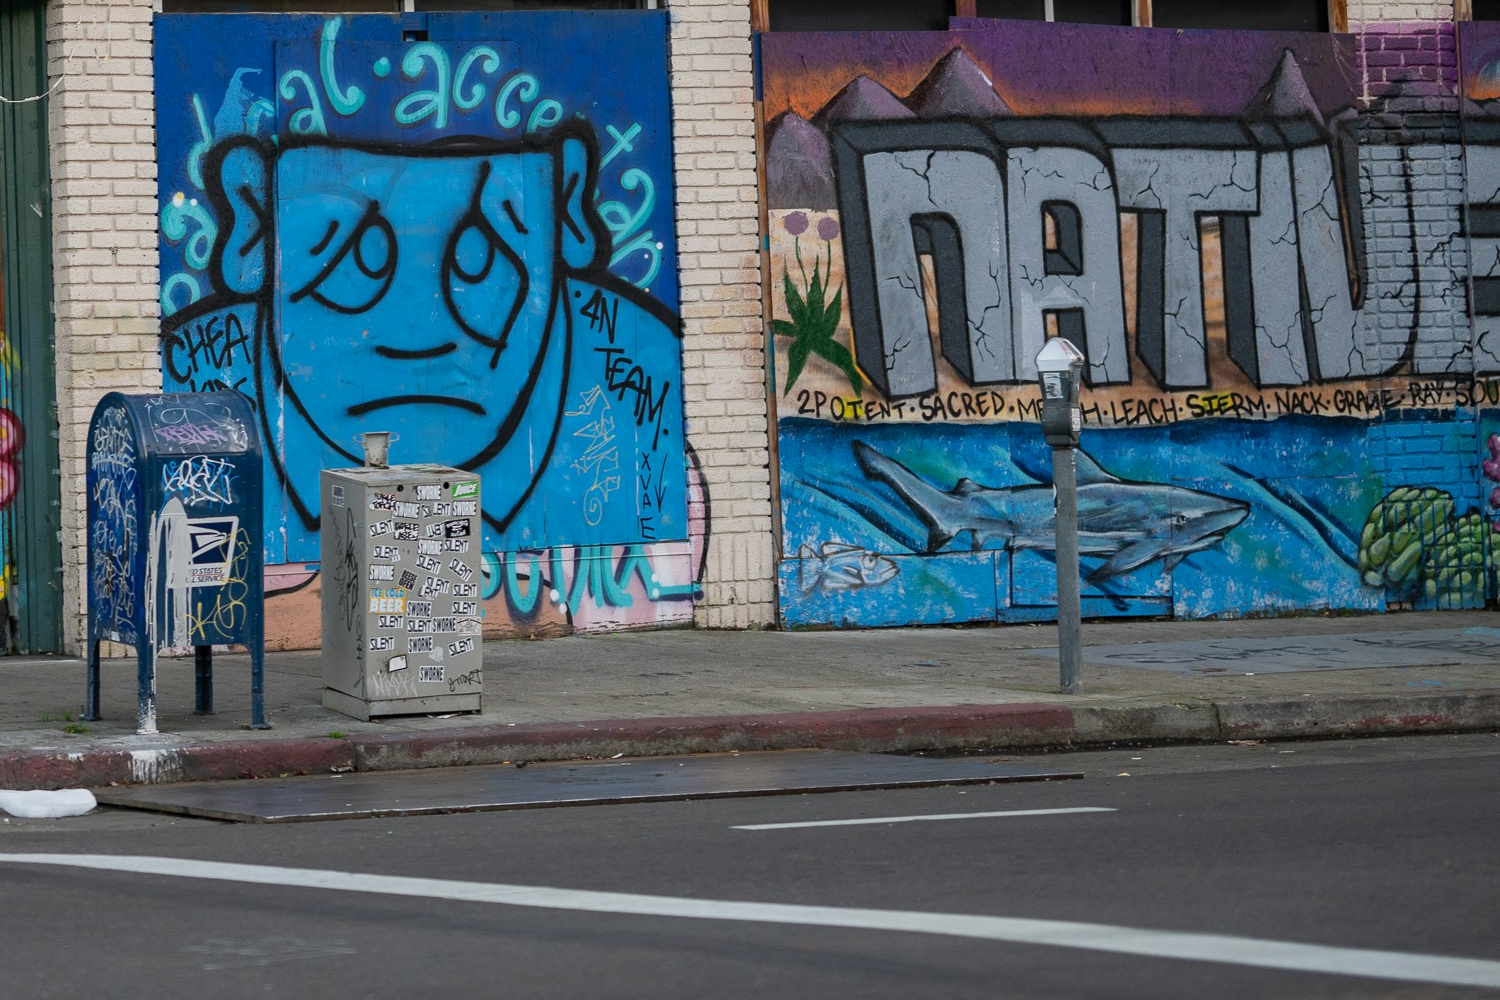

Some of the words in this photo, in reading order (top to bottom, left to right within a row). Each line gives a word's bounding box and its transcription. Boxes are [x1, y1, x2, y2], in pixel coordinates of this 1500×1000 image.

[918, 388, 1007, 422] SACRED
[1110, 397, 1178, 426] LEACH
[1274, 390, 1328, 417] NACK
[1407, 381, 1445, 407] RAY
[199, 567, 223, 575] STATES
[371, 588, 382, 597] ICE
[385, 587, 404, 597] COLD
[370, 598, 404, 613] BEER
